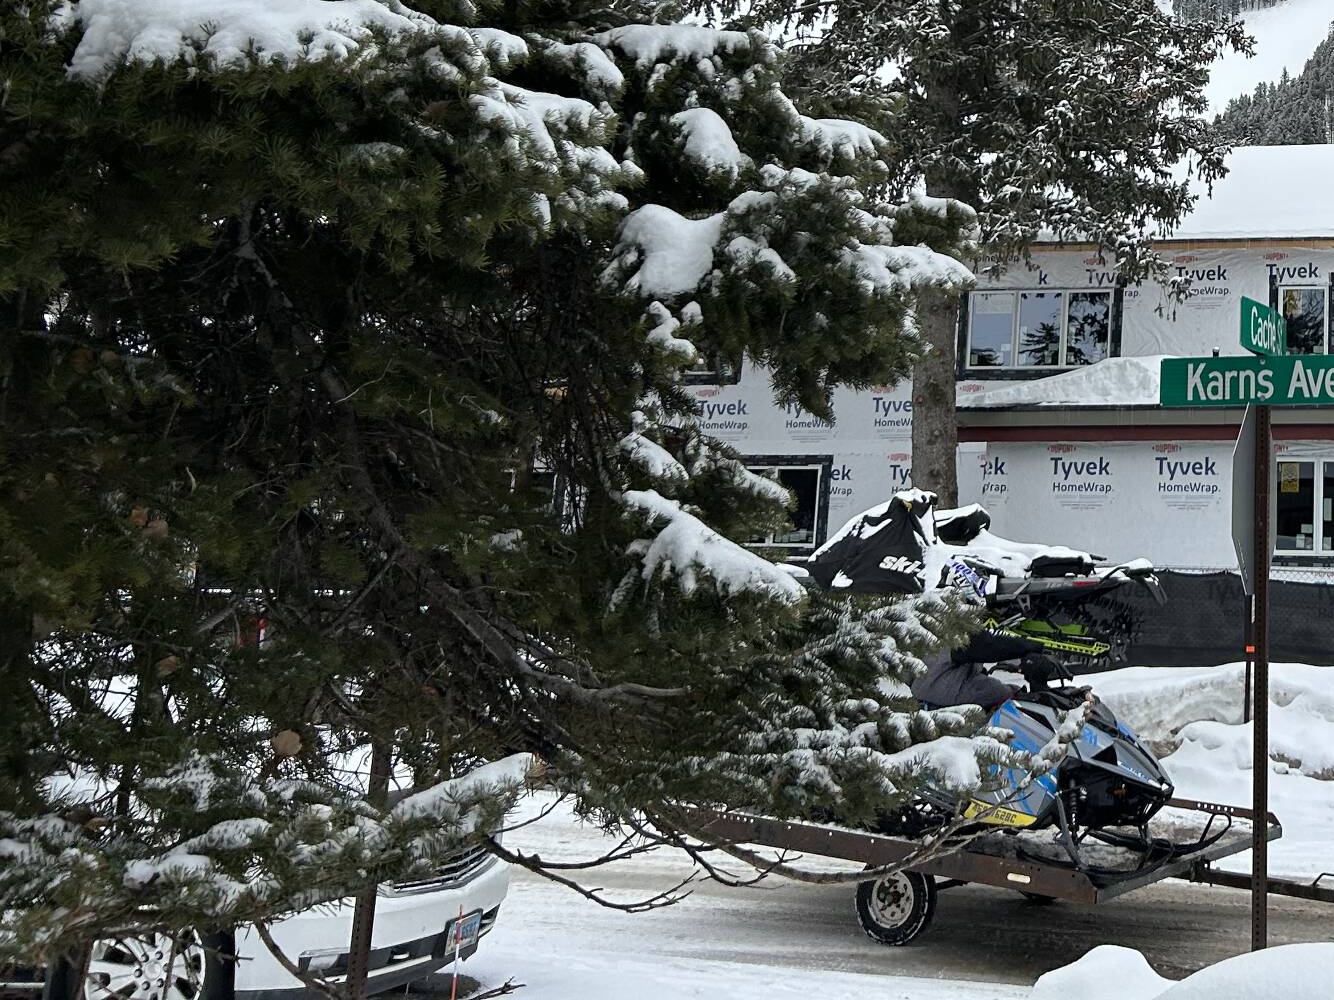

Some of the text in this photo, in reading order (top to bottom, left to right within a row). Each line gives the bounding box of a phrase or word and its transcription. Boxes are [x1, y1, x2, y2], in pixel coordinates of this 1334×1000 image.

[1086, 269, 1116, 287] Tyv
[1266, 262, 1318, 283] Tyvek
[1250, 305, 1276, 353] Cache
[1187, 362, 1275, 401] Karns
[873, 397, 911, 417] Tyve
[1050, 457, 1110, 481] Tyvek
[1155, 456, 1217, 481] Tyvek
[1052, 482, 1112, 494] HomeWrap
[1158, 482, 1218, 494] HomeWrap
